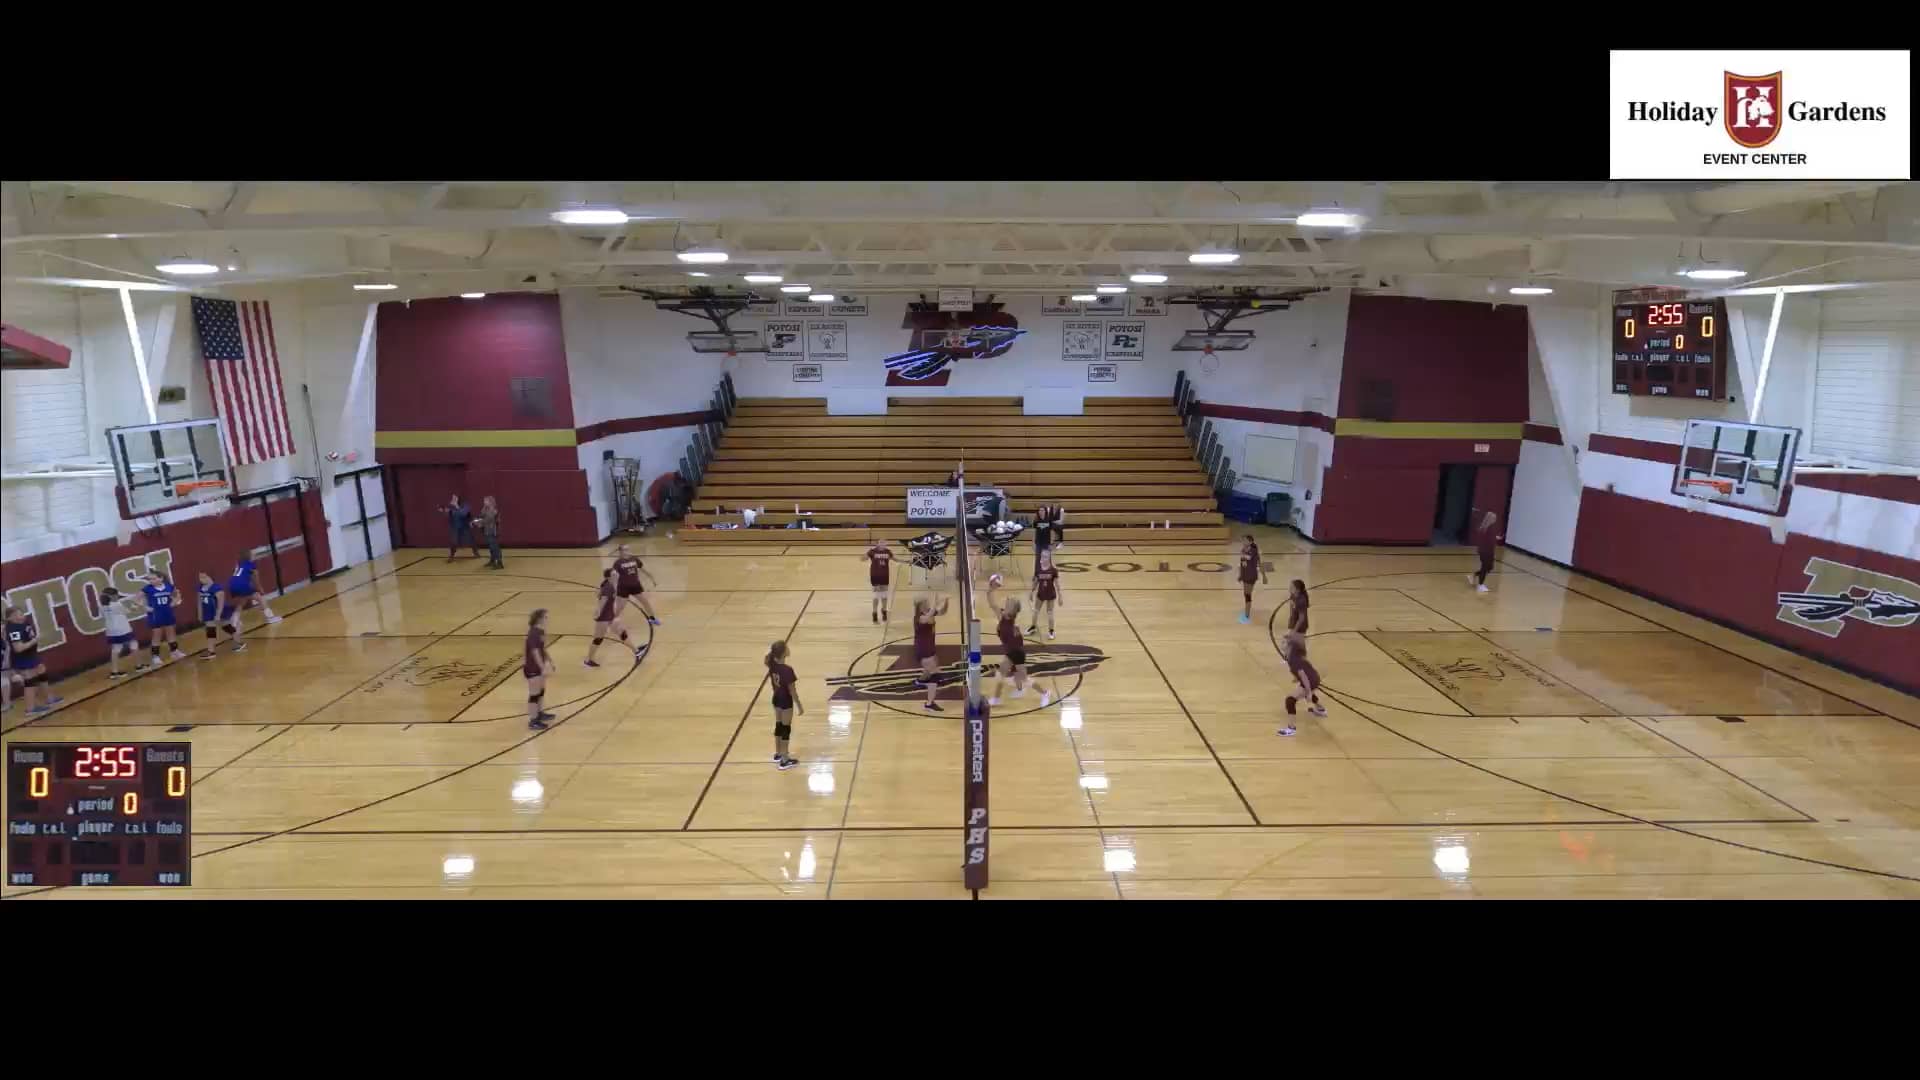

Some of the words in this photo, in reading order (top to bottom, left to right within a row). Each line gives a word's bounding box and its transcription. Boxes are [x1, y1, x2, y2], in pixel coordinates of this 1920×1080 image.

[1648, 303, 1683, 325] 2:55
[767, 324, 801, 332] POTOSI
[1108, 325, 1144, 333] POTOSI
[1624, 318, 1636, 338] 0
[1701, 315, 1714, 338] 0
[1675, 334, 1685, 350] 0
[910, 507, 946, 516] POTOSI
